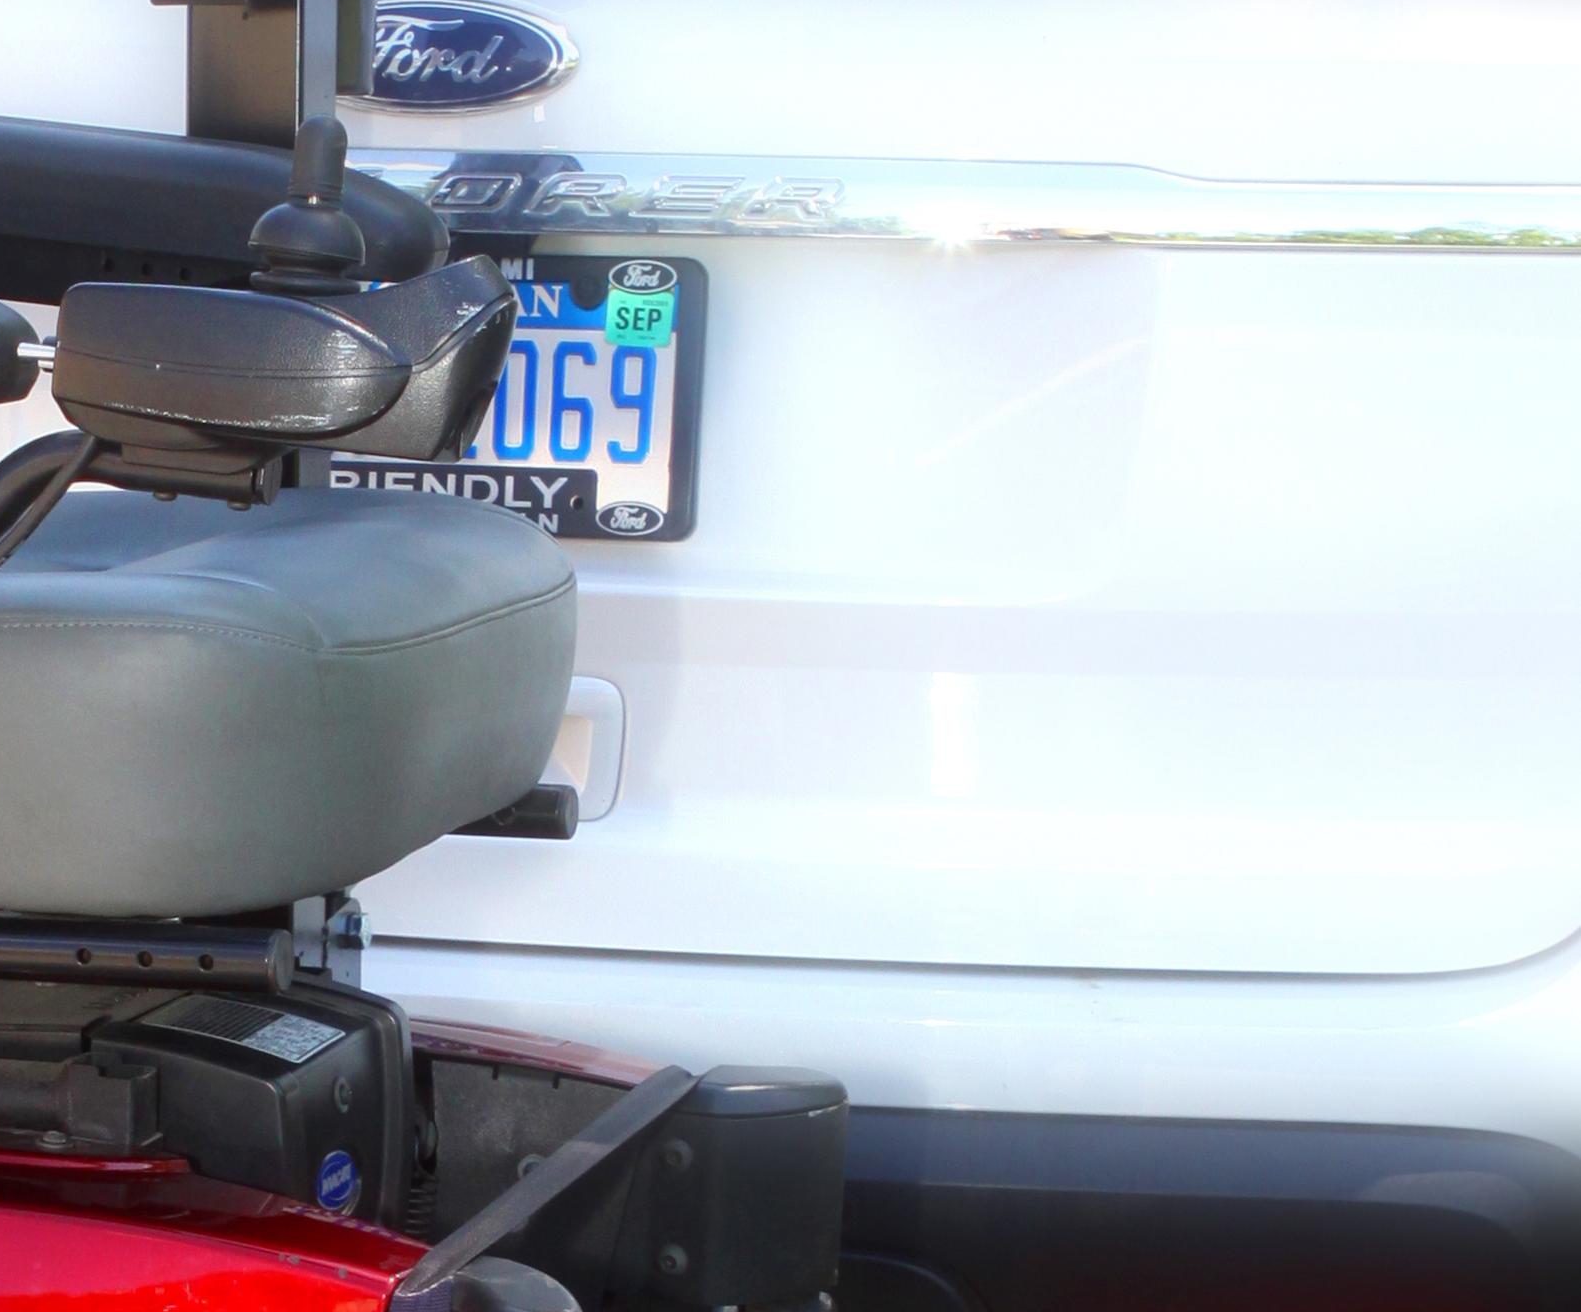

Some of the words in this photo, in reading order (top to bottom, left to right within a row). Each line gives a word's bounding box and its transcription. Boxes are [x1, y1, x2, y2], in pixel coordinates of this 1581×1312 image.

[372, 14, 504, 84] Ford
[426, 172, 847, 219] ORER
[622, 264, 662, 288] Ford
[614, 305, 663, 332] SEP
[463, 339, 658, 464] 069
[329, 470, 569, 510] RIENDLY
[609, 506, 648, 530] Ford
